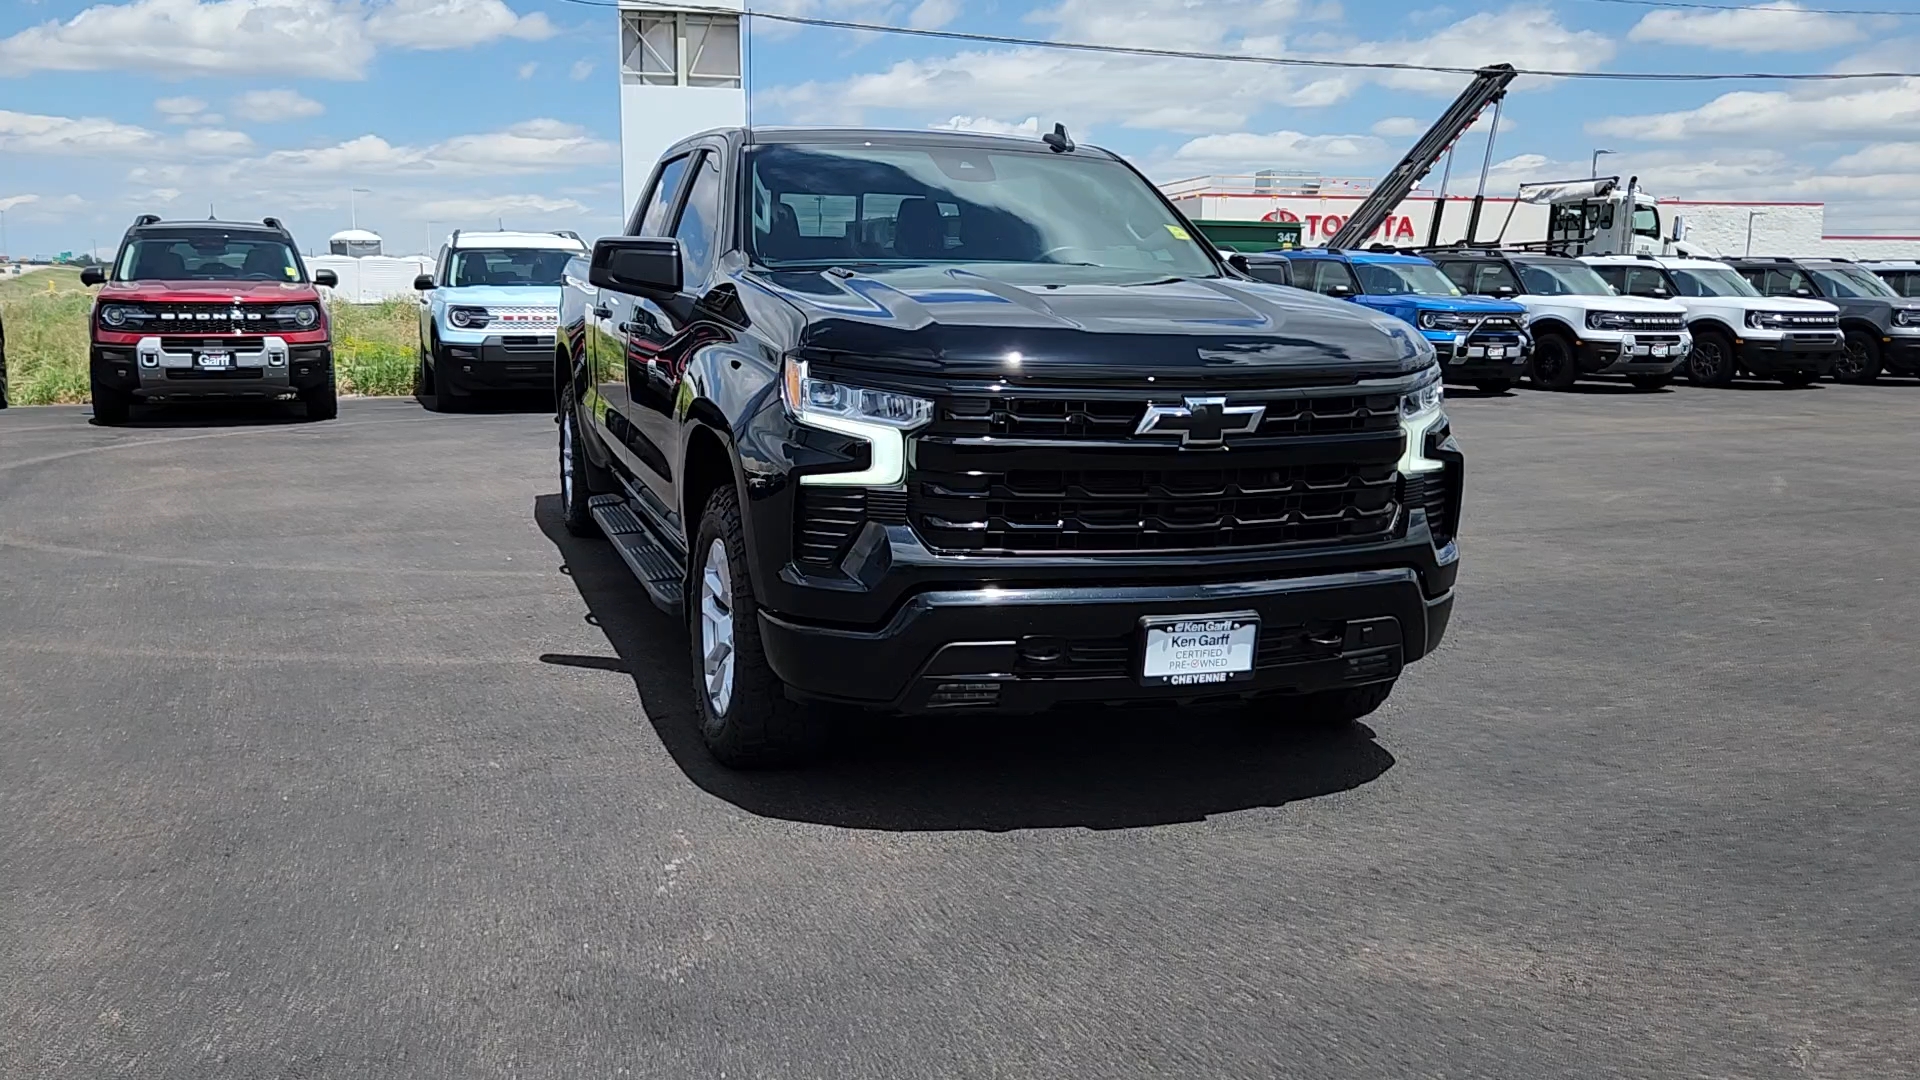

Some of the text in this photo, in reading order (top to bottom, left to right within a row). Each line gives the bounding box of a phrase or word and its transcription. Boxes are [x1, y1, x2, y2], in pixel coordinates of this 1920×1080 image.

[1305, 215, 1415, 237] TOTA
[1277, 232, 1298, 242] 347
[1184, 620, 1232, 633] Ken Garff
[1171, 634, 1230, 648] Ken Garff
[1175, 649, 1223, 659] CERTIFIED
[1169, 659, 1228, 669] PRE-OWNED
[1171, 672, 1227, 685] CHEYENNE
